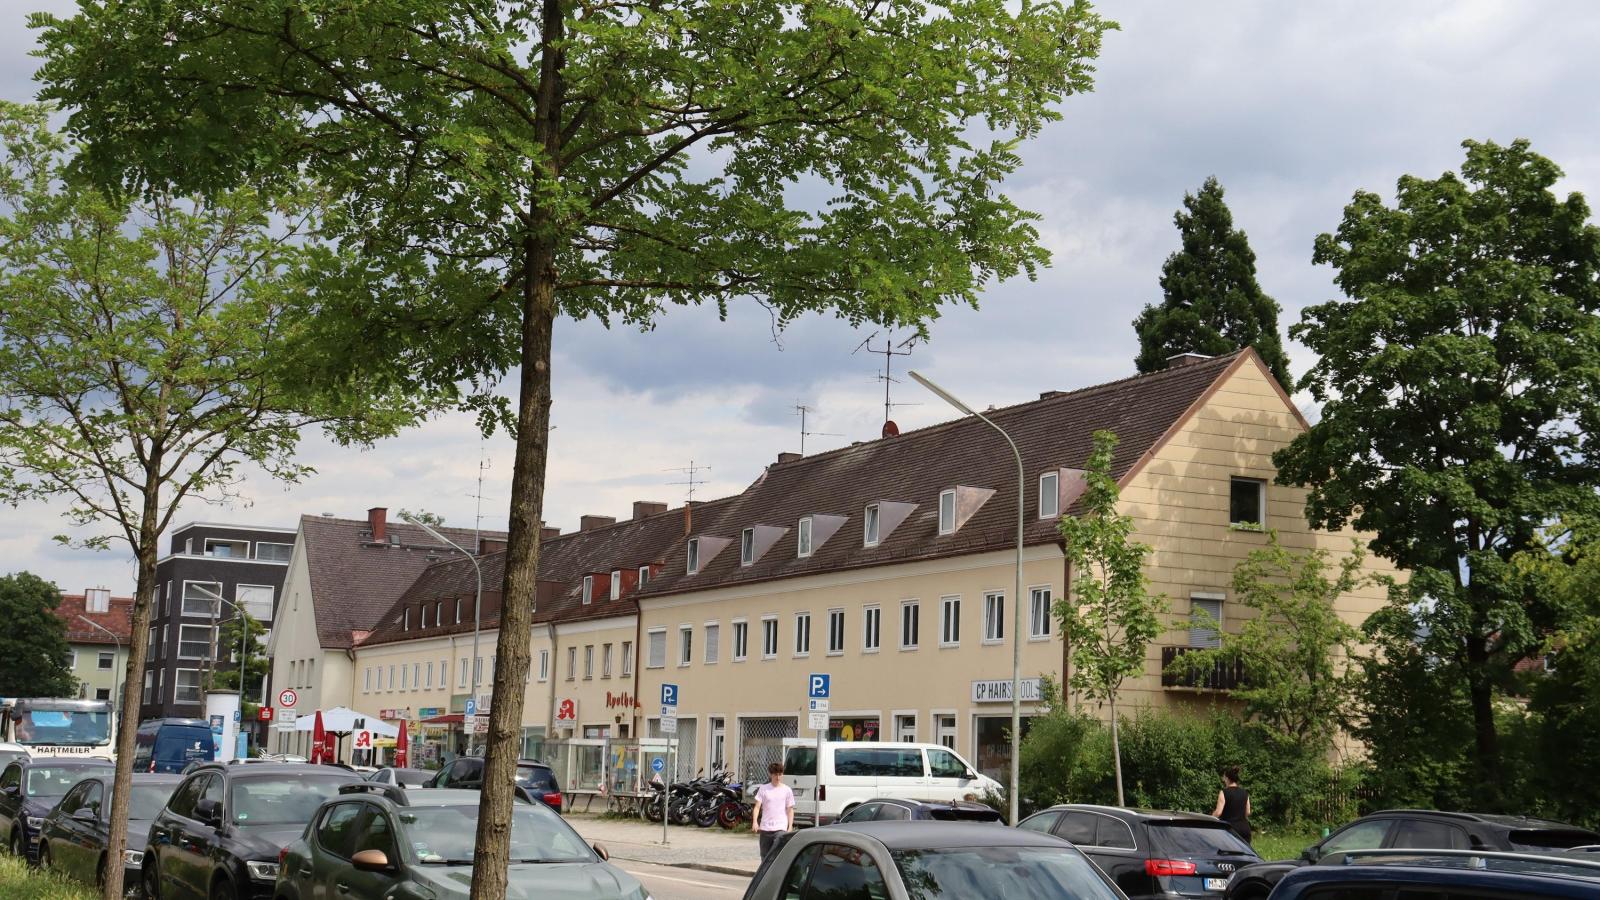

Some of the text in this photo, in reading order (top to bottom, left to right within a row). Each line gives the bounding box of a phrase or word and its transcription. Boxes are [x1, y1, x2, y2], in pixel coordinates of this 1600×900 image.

[812, 676, 824, 695] P
[976, 681, 1034, 699] CP HAIRSOOL
[283, 694, 294, 703] 30
[663, 686, 673, 702] P
[467, 701, 474, 713] P
